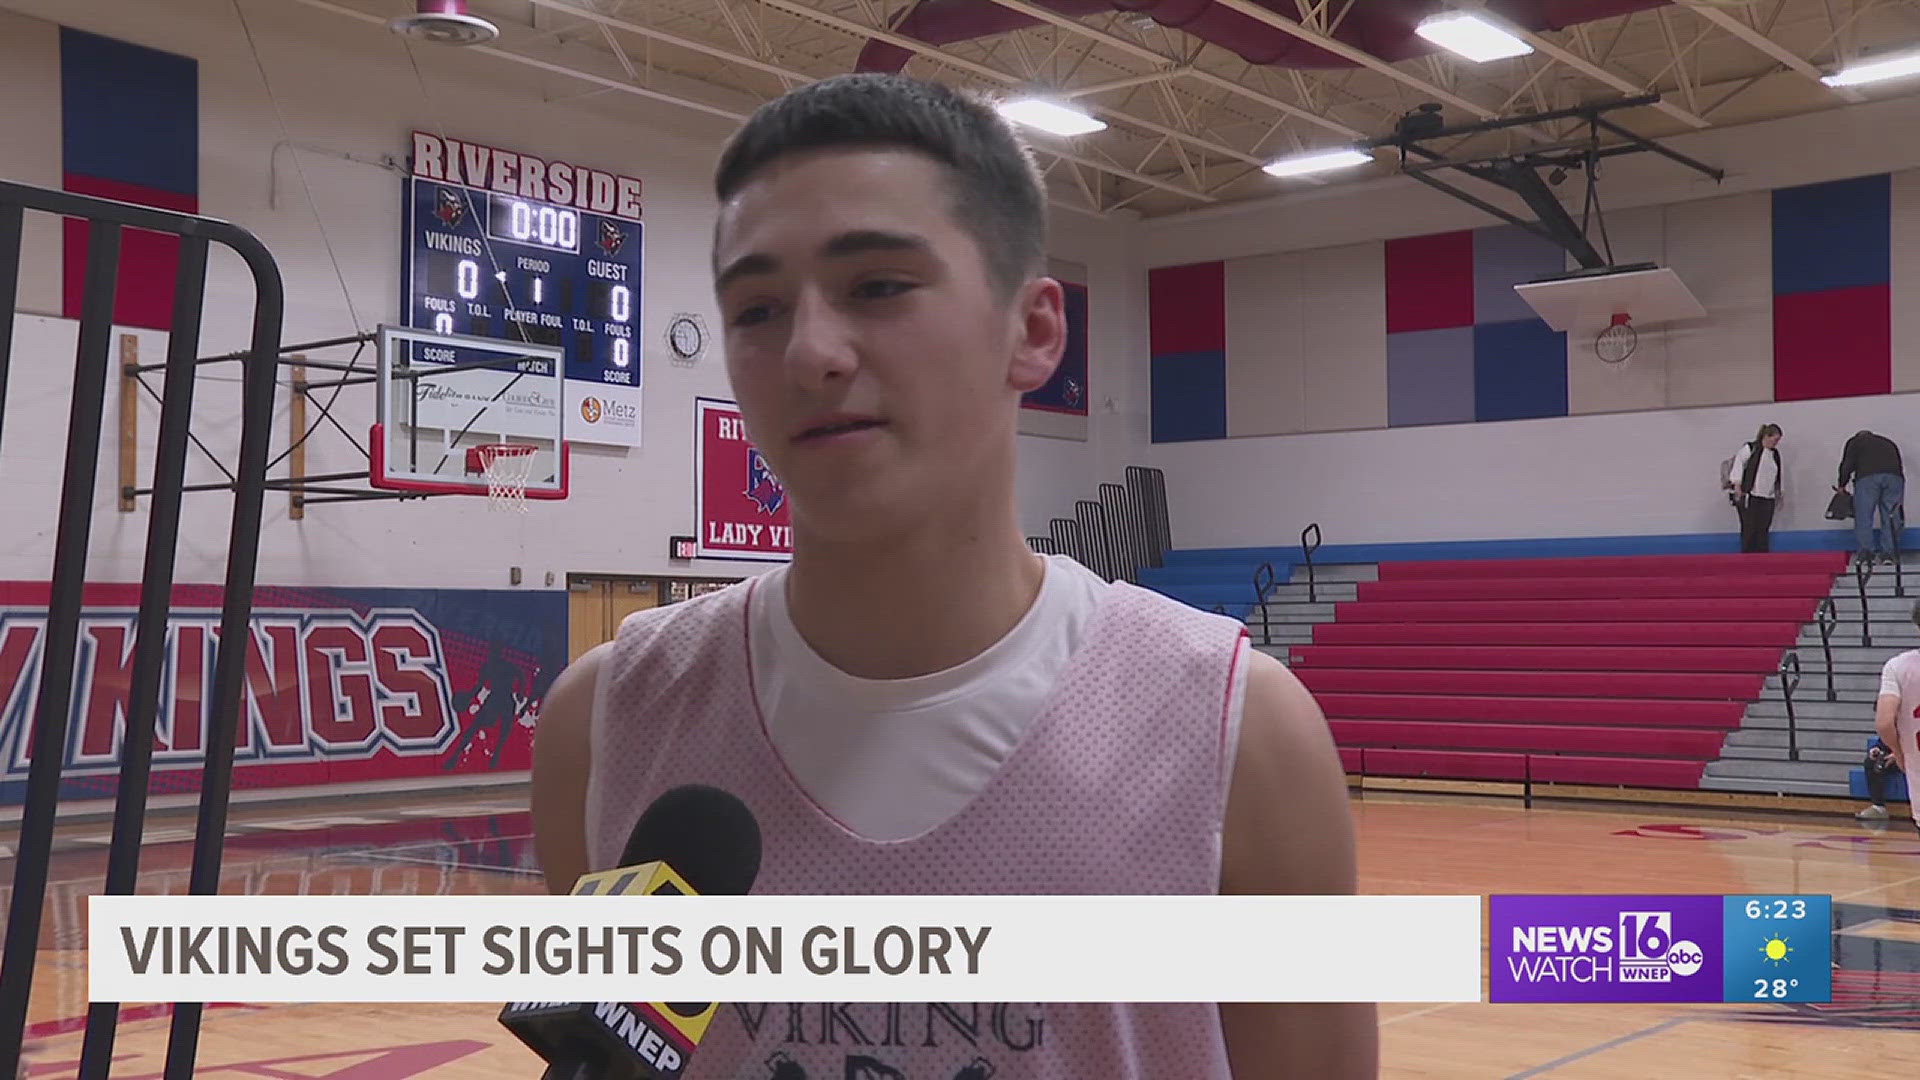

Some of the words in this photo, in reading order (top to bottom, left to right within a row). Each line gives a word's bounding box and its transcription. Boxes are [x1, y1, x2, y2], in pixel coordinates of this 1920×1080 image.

[413, 132, 642, 219] RIVERSIDE
[511, 201, 577, 249] 0:00
[425, 231, 482, 255] VIKINGS
[517, 257, 550, 273] PERIOD
[588, 260, 628, 281] GUEST
[458, 260, 478, 299] 0
[424, 296, 456, 312] FOULS
[611, 286, 630, 322] 0
[504, 308, 538, 325] PLAYER
[540, 313, 563, 328] FOUL
[604, 323, 632, 338] FOULS
[424, 347, 456, 363] SCORE
[614, 338, 630, 367] 0
[603, 370, 632, 385] SCORE
[603, 399, 637, 418] Metz
[709, 522, 764, 546] LADY
[0, 608, 458, 776] KINGS
[594, 1002, 681, 1072] WNEP
